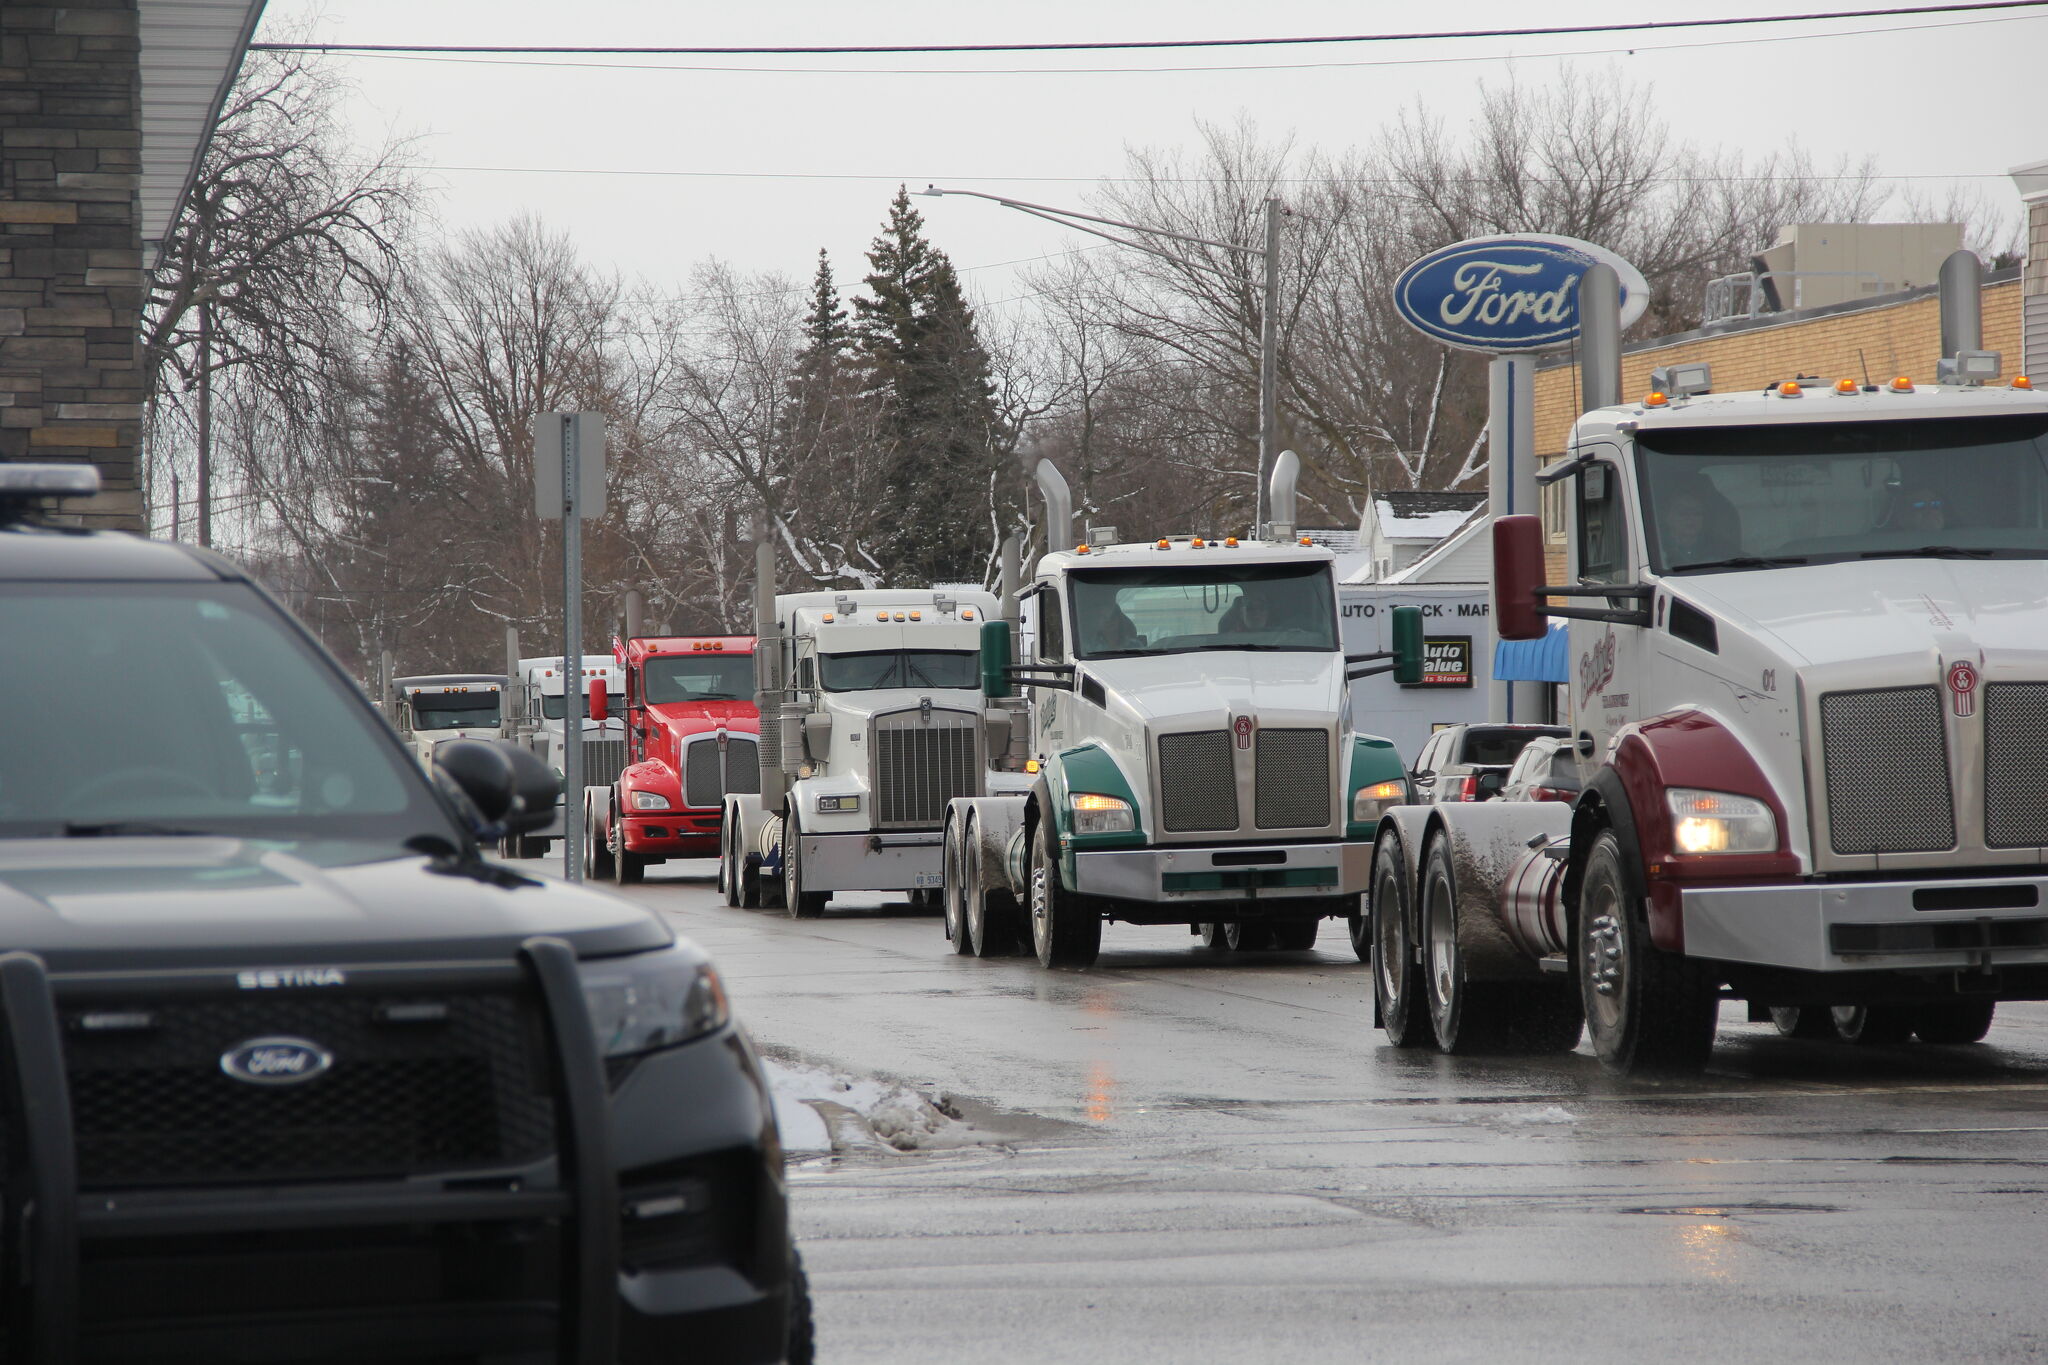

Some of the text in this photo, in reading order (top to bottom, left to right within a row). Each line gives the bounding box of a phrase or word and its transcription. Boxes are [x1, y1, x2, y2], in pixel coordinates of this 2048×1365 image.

[1441, 261, 1578, 325] Ford
[1341, 604, 1375, 618] UTO
[1424, 658, 1463, 673] alue
[1762, 669, 1777, 692] 01
[237, 969, 346, 988] SETINA
[248, 1049, 307, 1074] Ford
